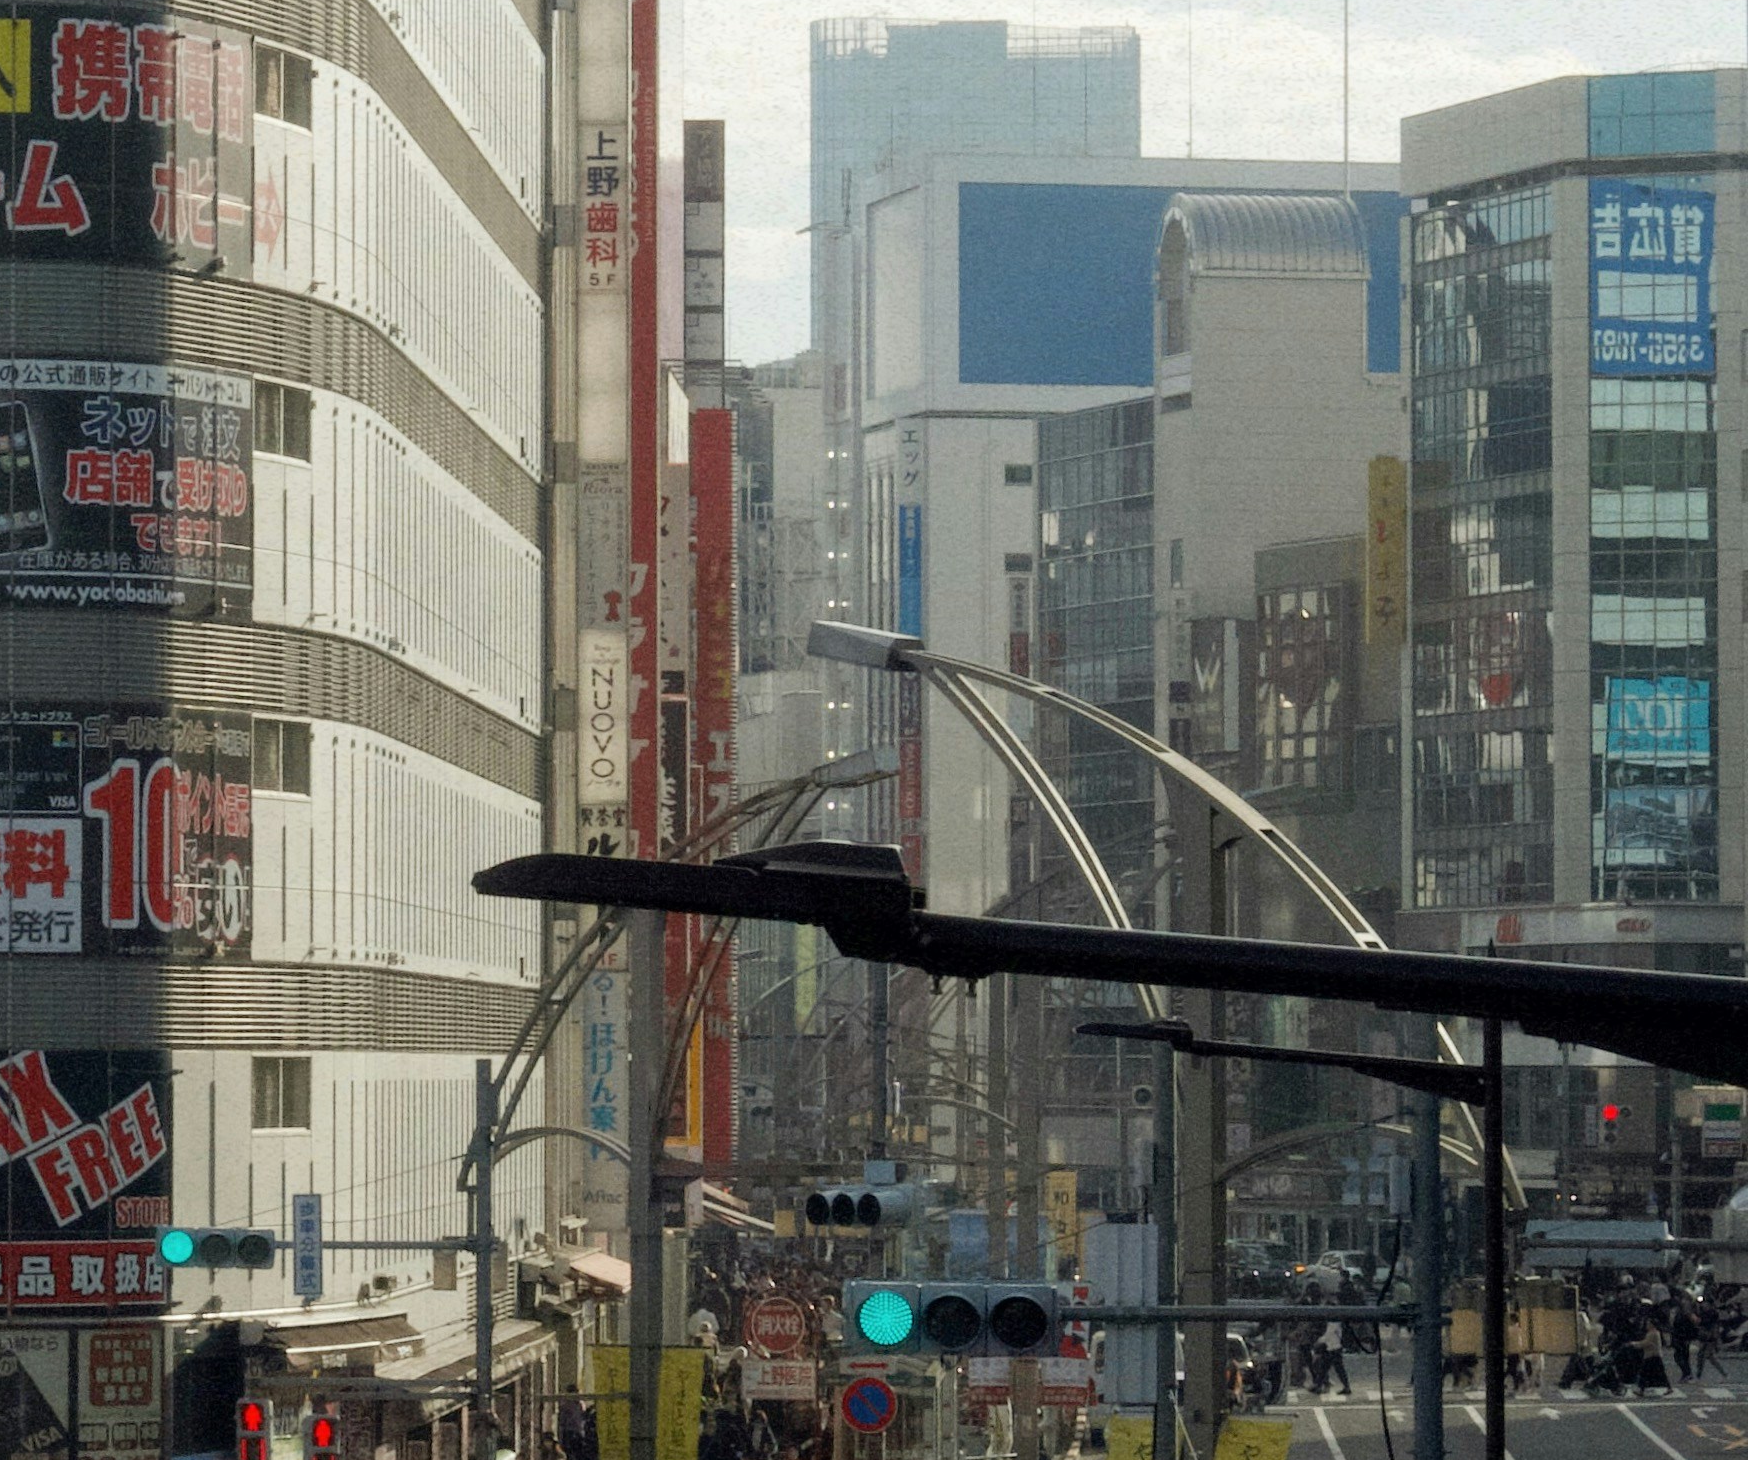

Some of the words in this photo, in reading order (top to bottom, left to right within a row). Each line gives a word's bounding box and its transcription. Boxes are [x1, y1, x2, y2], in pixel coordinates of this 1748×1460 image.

[53, 18, 245, 144] 携帯電話
[586, 130, 620, 268] 上野歯科
[63, 448, 248, 517] 店舗で受け取り
[49, 796, 77, 809] VISA
[25, 1080, 168, 1228] FREE
[114, 1195, 171, 1230] STORE
